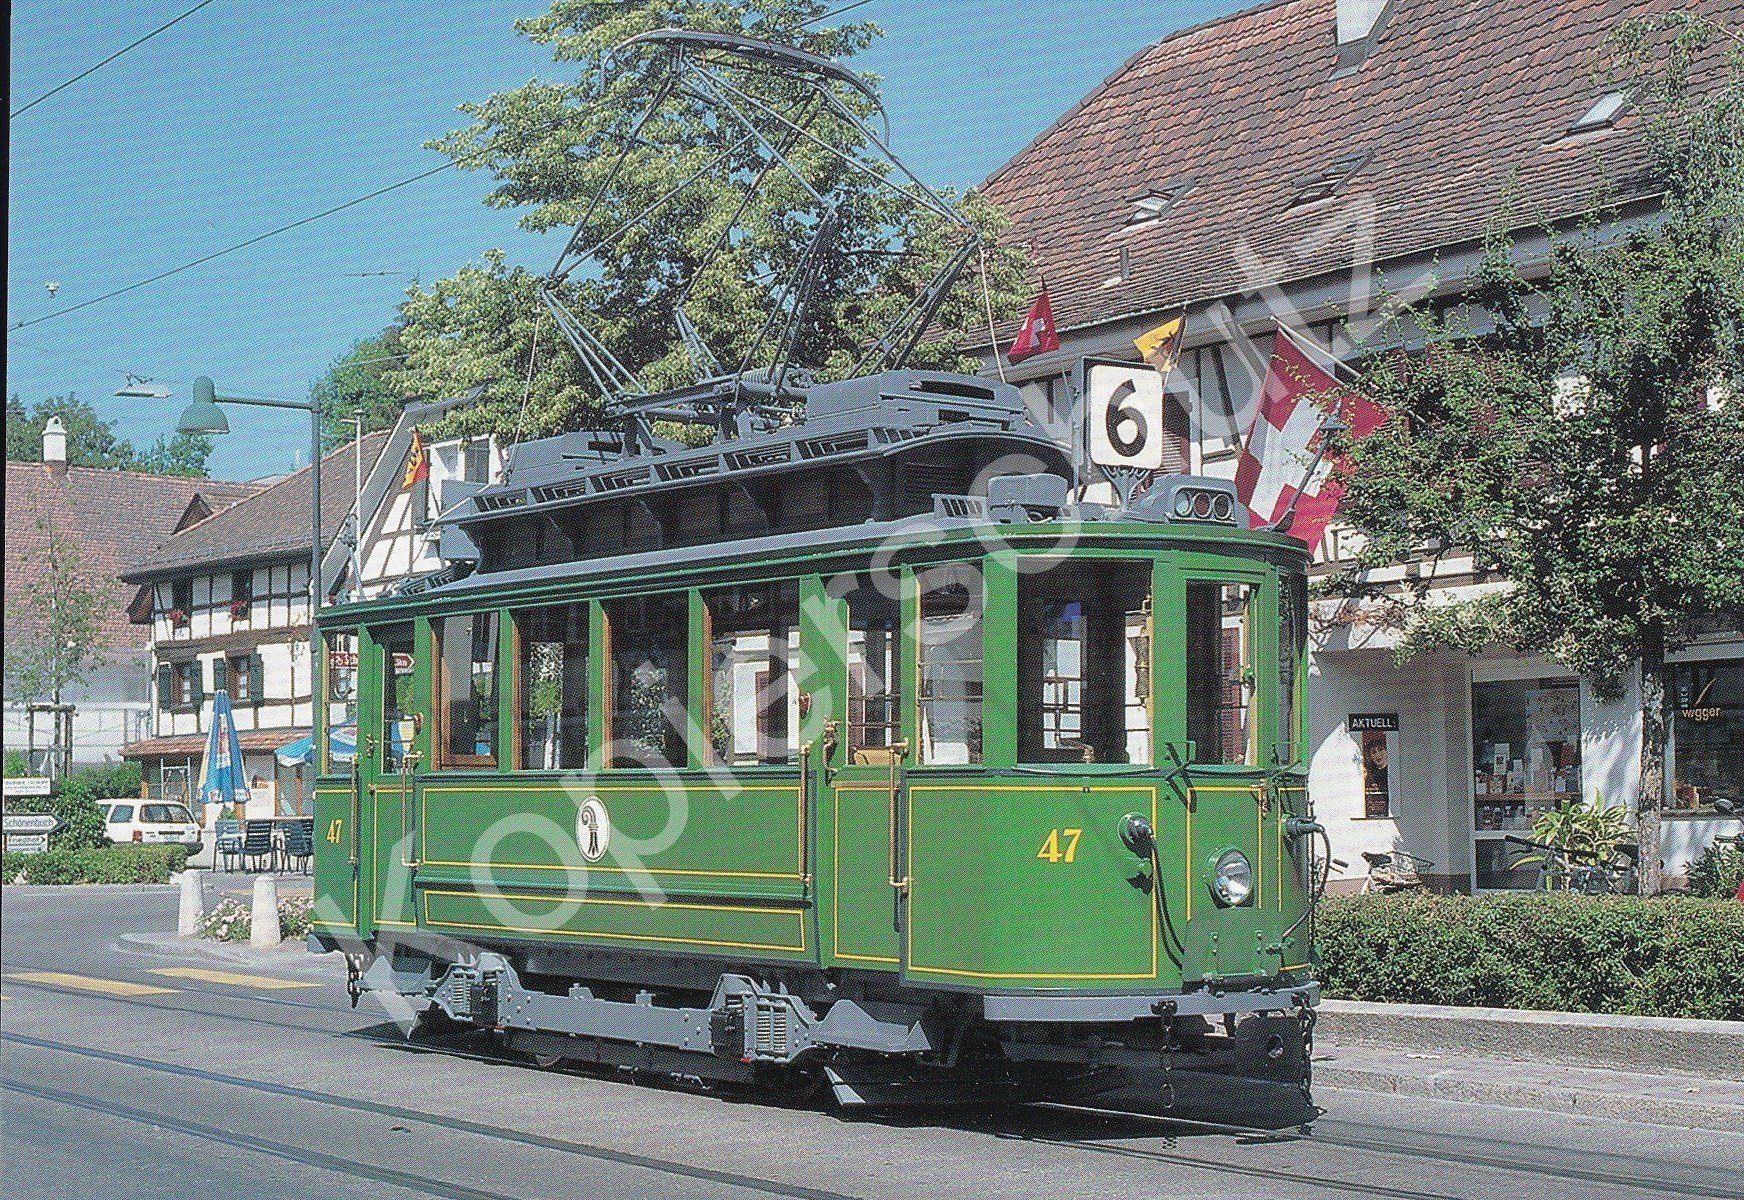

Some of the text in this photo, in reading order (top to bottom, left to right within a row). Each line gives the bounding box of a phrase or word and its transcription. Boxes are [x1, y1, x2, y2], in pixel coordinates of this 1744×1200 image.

[1106, 379, 1147, 458] 6
[327, 819, 343, 843] 47
[1036, 828, 1082, 863] 47
